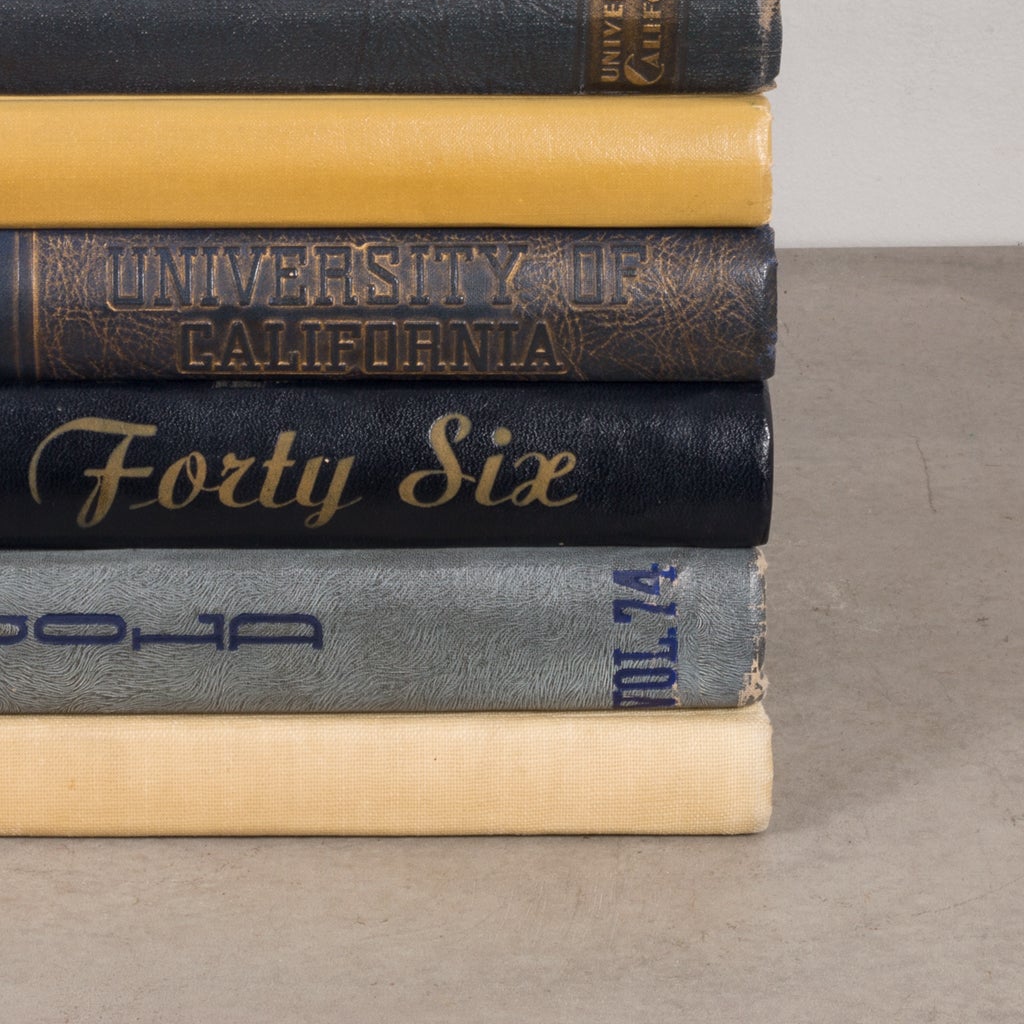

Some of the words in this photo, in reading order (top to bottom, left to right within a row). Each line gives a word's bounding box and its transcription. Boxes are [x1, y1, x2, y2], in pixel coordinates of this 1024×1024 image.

[107, 242, 529, 312] UNIVERSITY
[569, 242, 653, 312] OF
[177, 319, 570, 375] CALIFORNIA
[29, 416, 364, 528] Forty
[397, 412, 580, 509] Six
